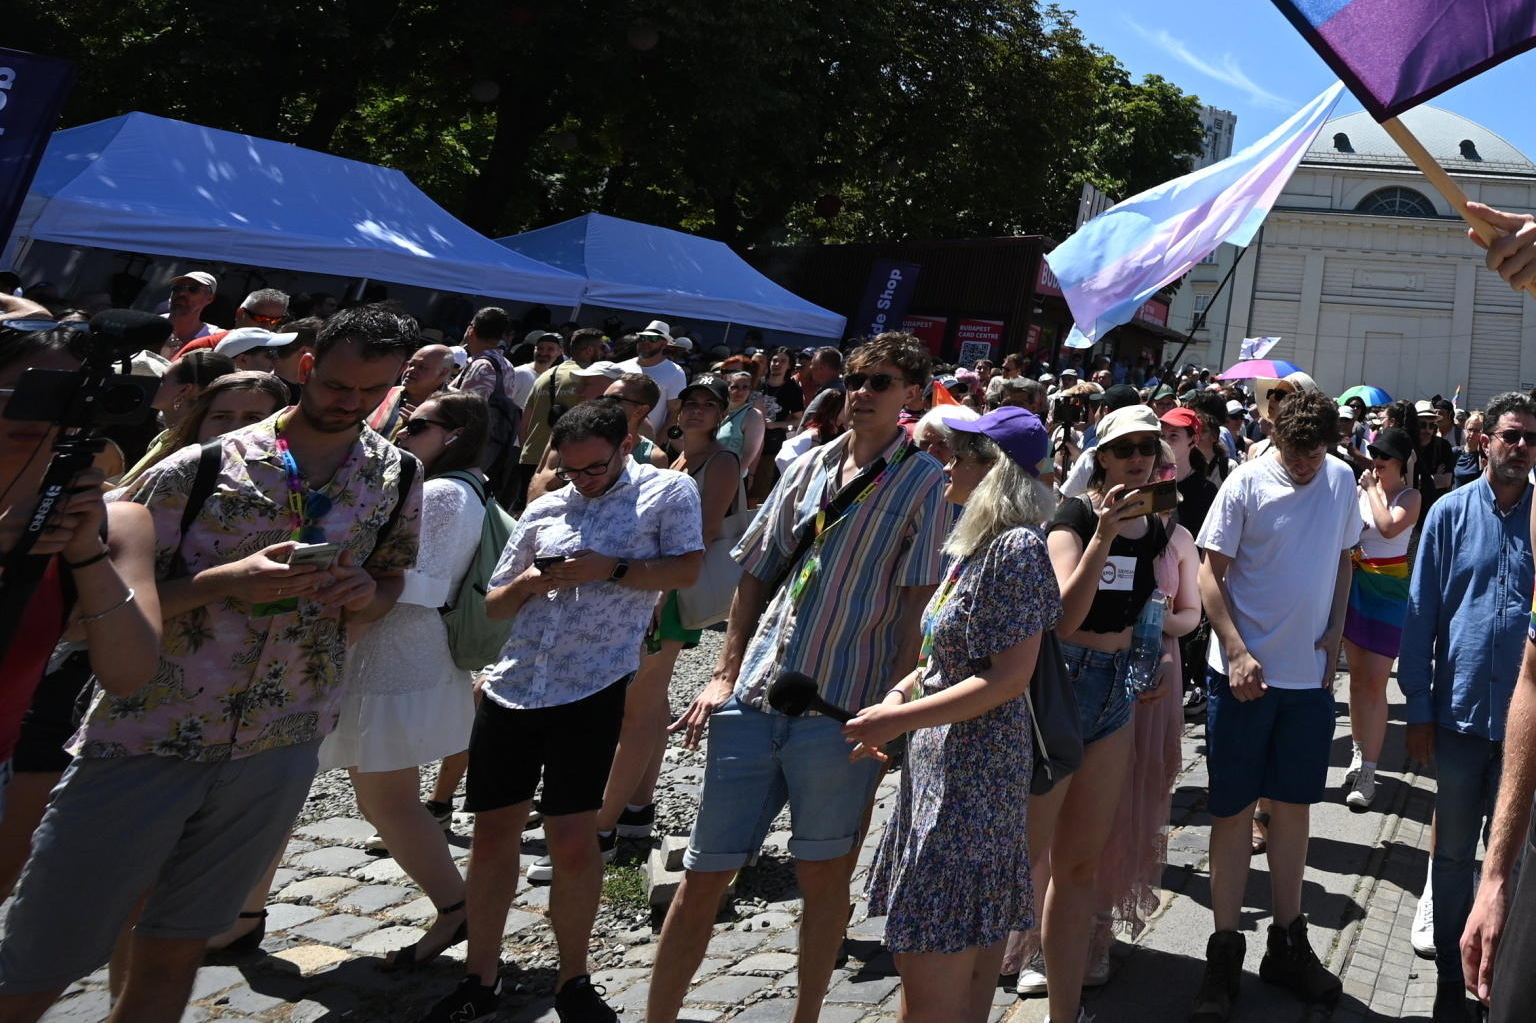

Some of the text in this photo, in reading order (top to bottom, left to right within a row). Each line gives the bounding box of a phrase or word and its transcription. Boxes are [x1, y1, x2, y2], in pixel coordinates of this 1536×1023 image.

[1041, 263, 1060, 289] BUD
[867, 268, 903, 339] ide Shop
[902, 320, 933, 328] UDAPEST
[959, 324, 992, 332] BUDAPEST
[975, 332, 999, 340] CENTRE
